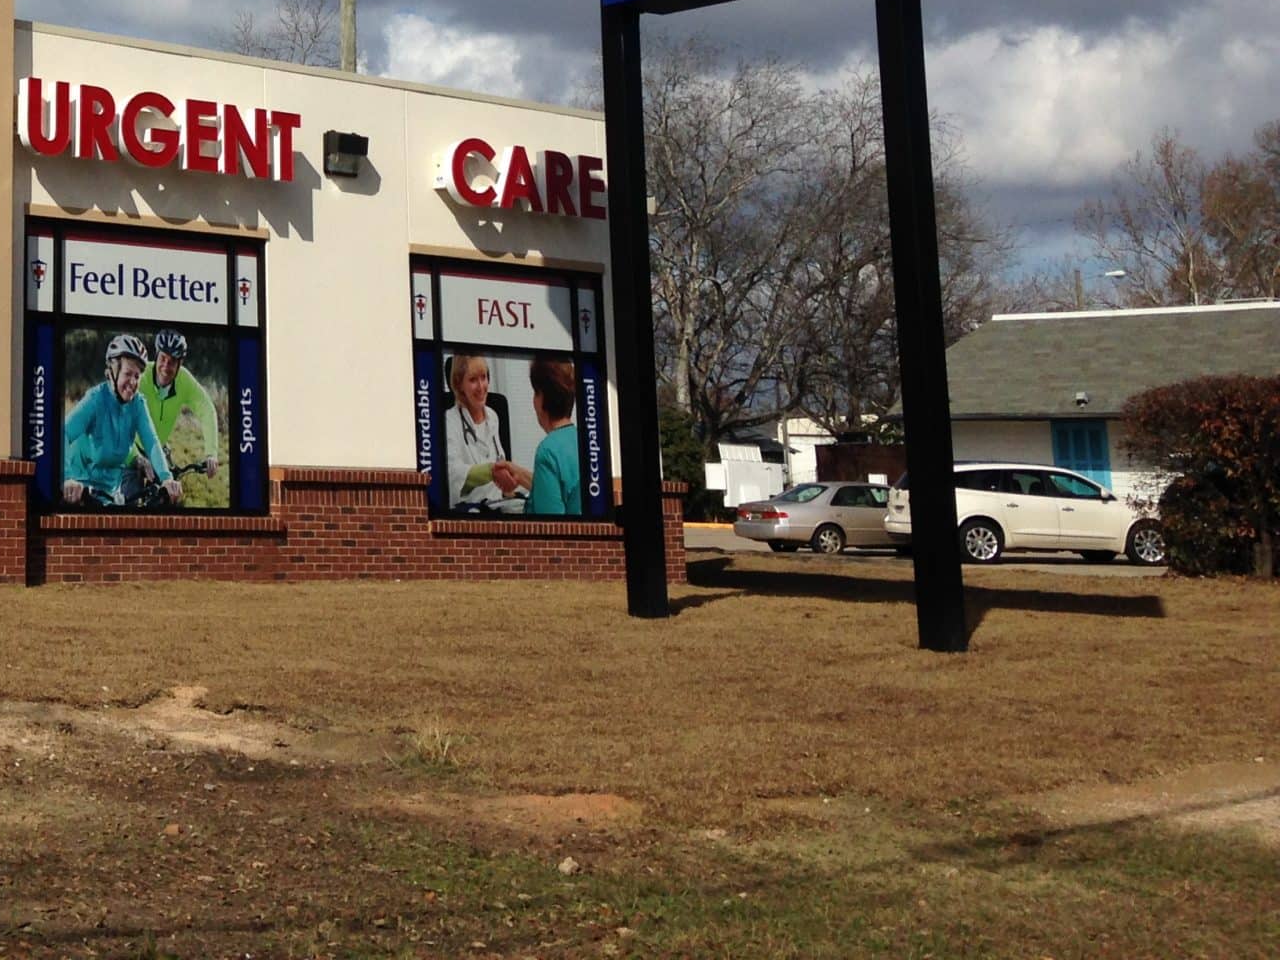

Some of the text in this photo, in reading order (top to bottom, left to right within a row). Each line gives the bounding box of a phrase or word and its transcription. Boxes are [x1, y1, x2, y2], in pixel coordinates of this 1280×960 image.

[26, 76, 607, 220] URGENT CARE
[69, 262, 220, 304] Feel Better.
[477, 297, 535, 330] FAST.
[29, 365, 45, 458] Wellness
[239, 387, 253, 453] Sports
[584, 378, 600, 497] Occupational
